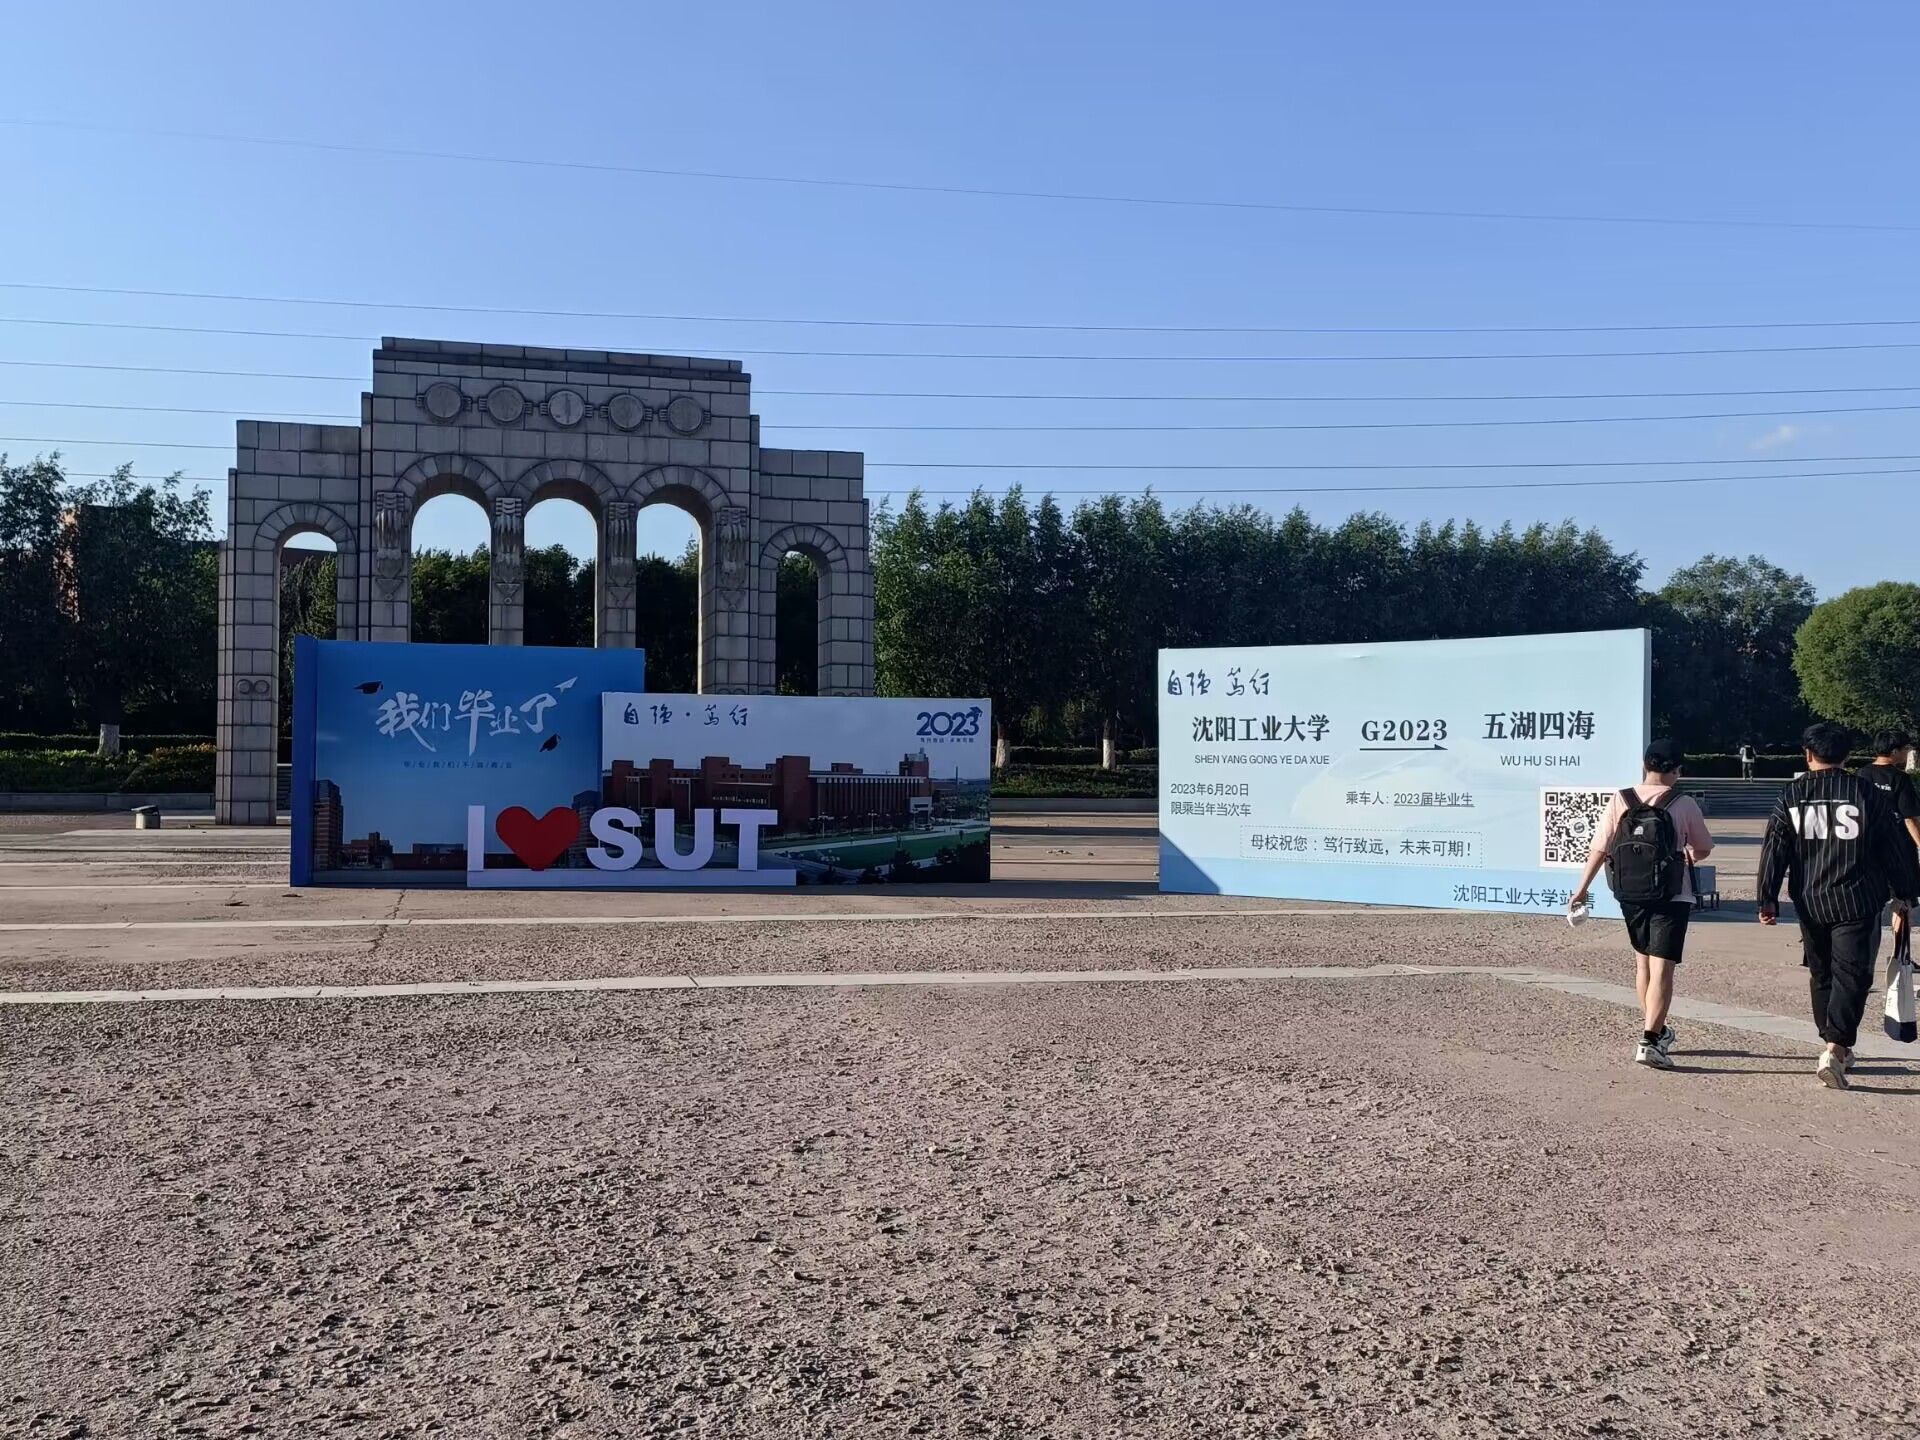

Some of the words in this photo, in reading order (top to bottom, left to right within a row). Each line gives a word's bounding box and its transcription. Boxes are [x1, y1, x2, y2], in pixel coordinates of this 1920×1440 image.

[375, 689, 558, 757] 我们毕业了
[916, 708, 982, 736] 2023
[1191, 713, 1331, 743] 沈阳工业大学
[1361, 719, 1448, 742] G2023
[1481, 710, 1596, 741] 五湖四海
[1194, 754, 1220, 765] SHEN
[1221, 754, 1247, 765] YANG
[1249, 754, 1278, 765] GONG
[1279, 754, 1293, 765] YE
[1294, 755, 1309, 765] DA
[1309, 755, 1330, 765] XUE
[1500, 755, 1521, 767] WU
[1524, 755, 1541, 767] HU
[1545, 755, 1557, 767] SI
[1559, 755, 1581, 767] HAI
[1170, 782, 1250, 797] 2023年6月20日
[1170, 801, 1252, 817] 限乘当年当次车
[467, 805, 486, 872] I
[586, 807, 778, 873] SUT
